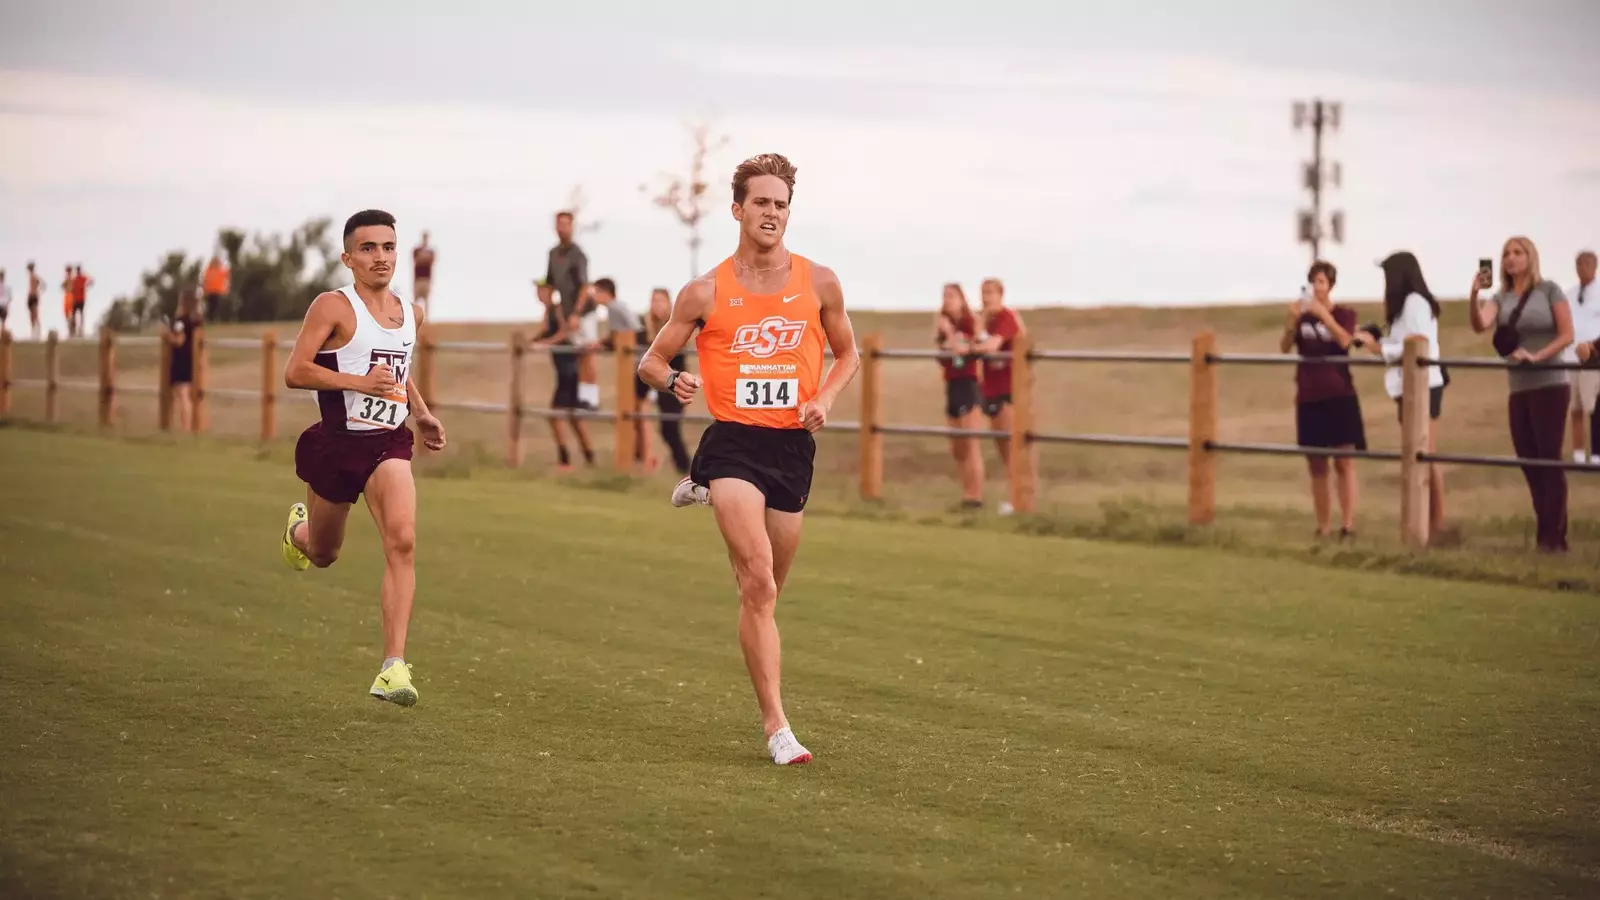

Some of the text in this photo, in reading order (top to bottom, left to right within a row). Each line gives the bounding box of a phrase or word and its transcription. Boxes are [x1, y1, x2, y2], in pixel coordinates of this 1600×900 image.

[730, 316, 807, 358] OSU
[745, 381, 790, 405] 314
[360, 397, 398, 425] 321
